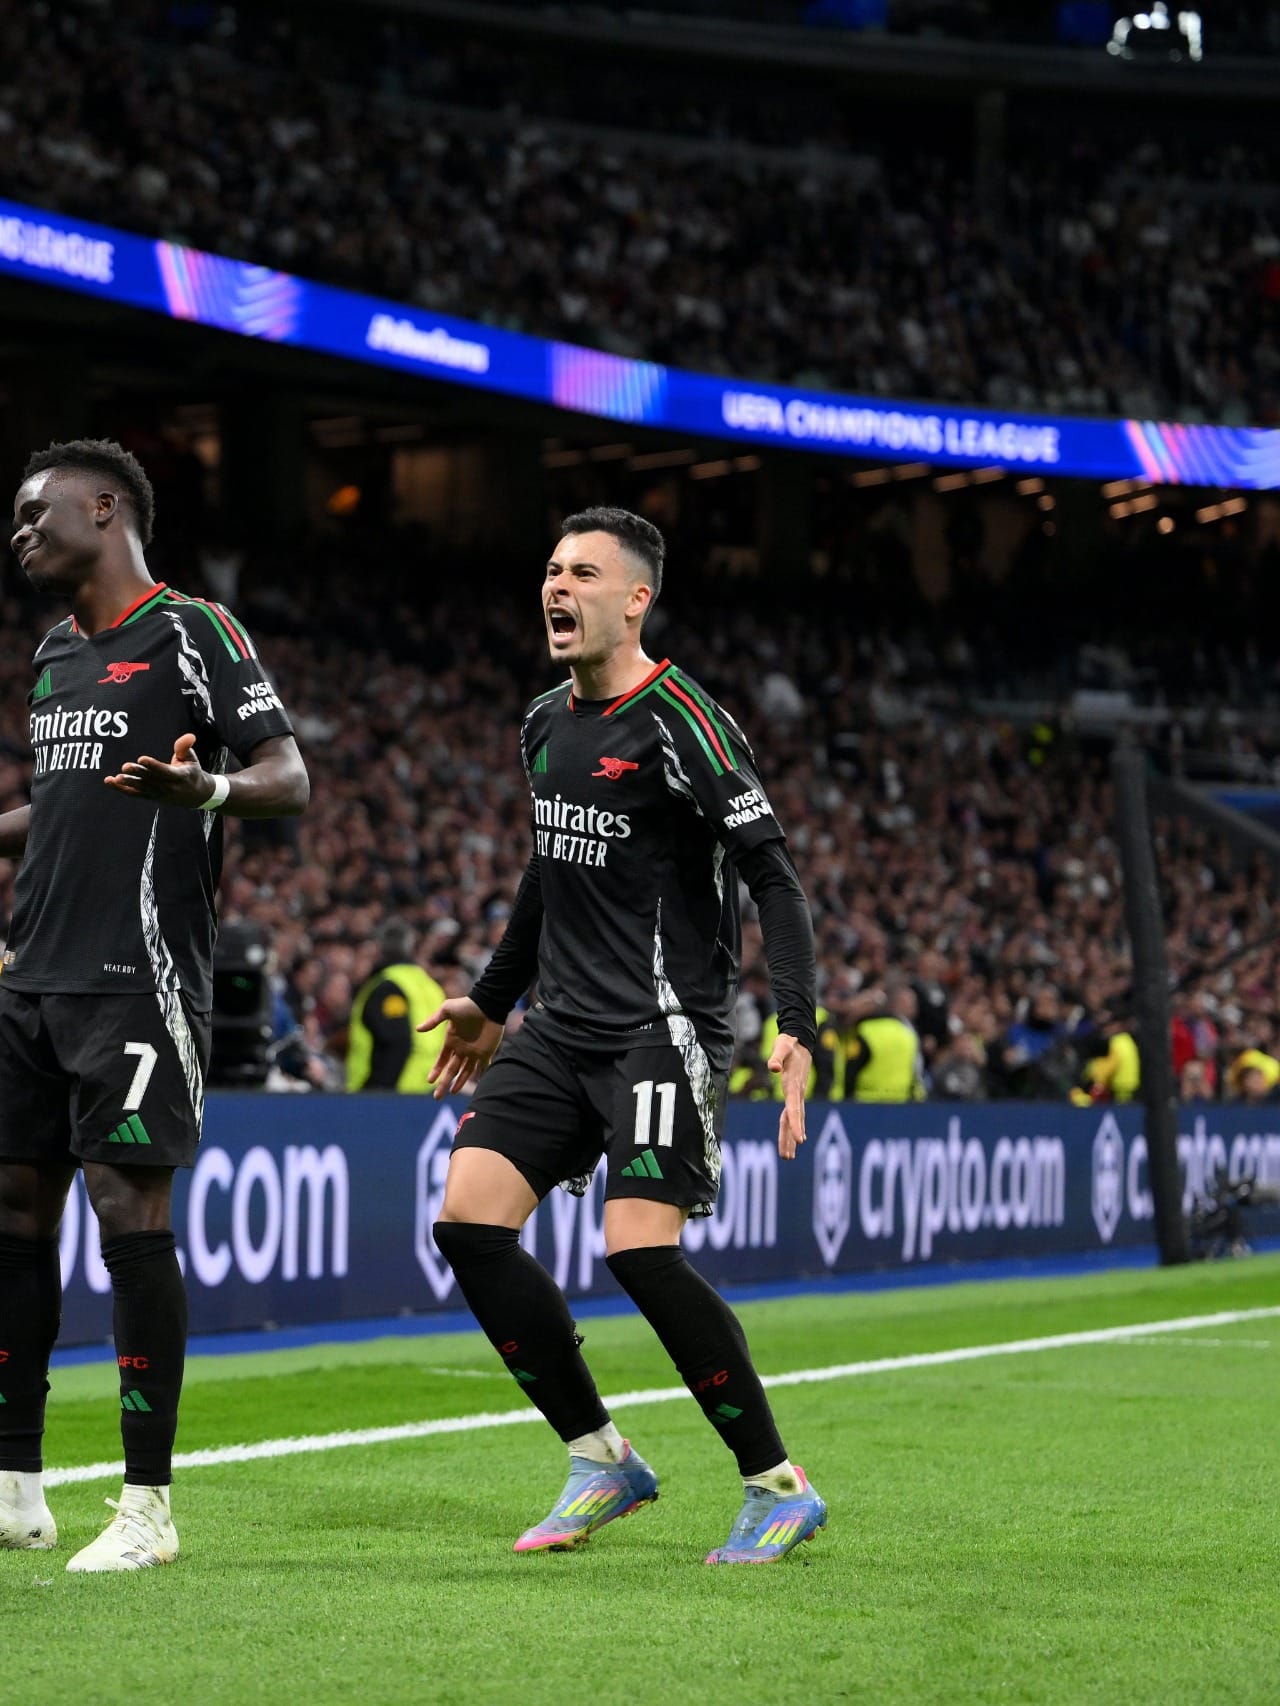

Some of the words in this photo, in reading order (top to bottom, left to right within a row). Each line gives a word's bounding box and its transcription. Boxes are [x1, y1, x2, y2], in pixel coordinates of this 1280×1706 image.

[21, 220, 115, 284] LEAGUE
[722, 390, 784, 434] UEFA
[785, 399, 944, 454] CHAMPIONS
[944, 417, 1060, 464] LEAGUE
[50, 742, 104, 771] BETTER
[531, 791, 631, 838] mirates
[536, 830, 550, 857] FLY
[553, 833, 608, 868] BETTER
[122, 1041, 159, 1111] 7
[632, 1080, 677, 1148] 11
[859, 1115, 1066, 1264] crypto.com
